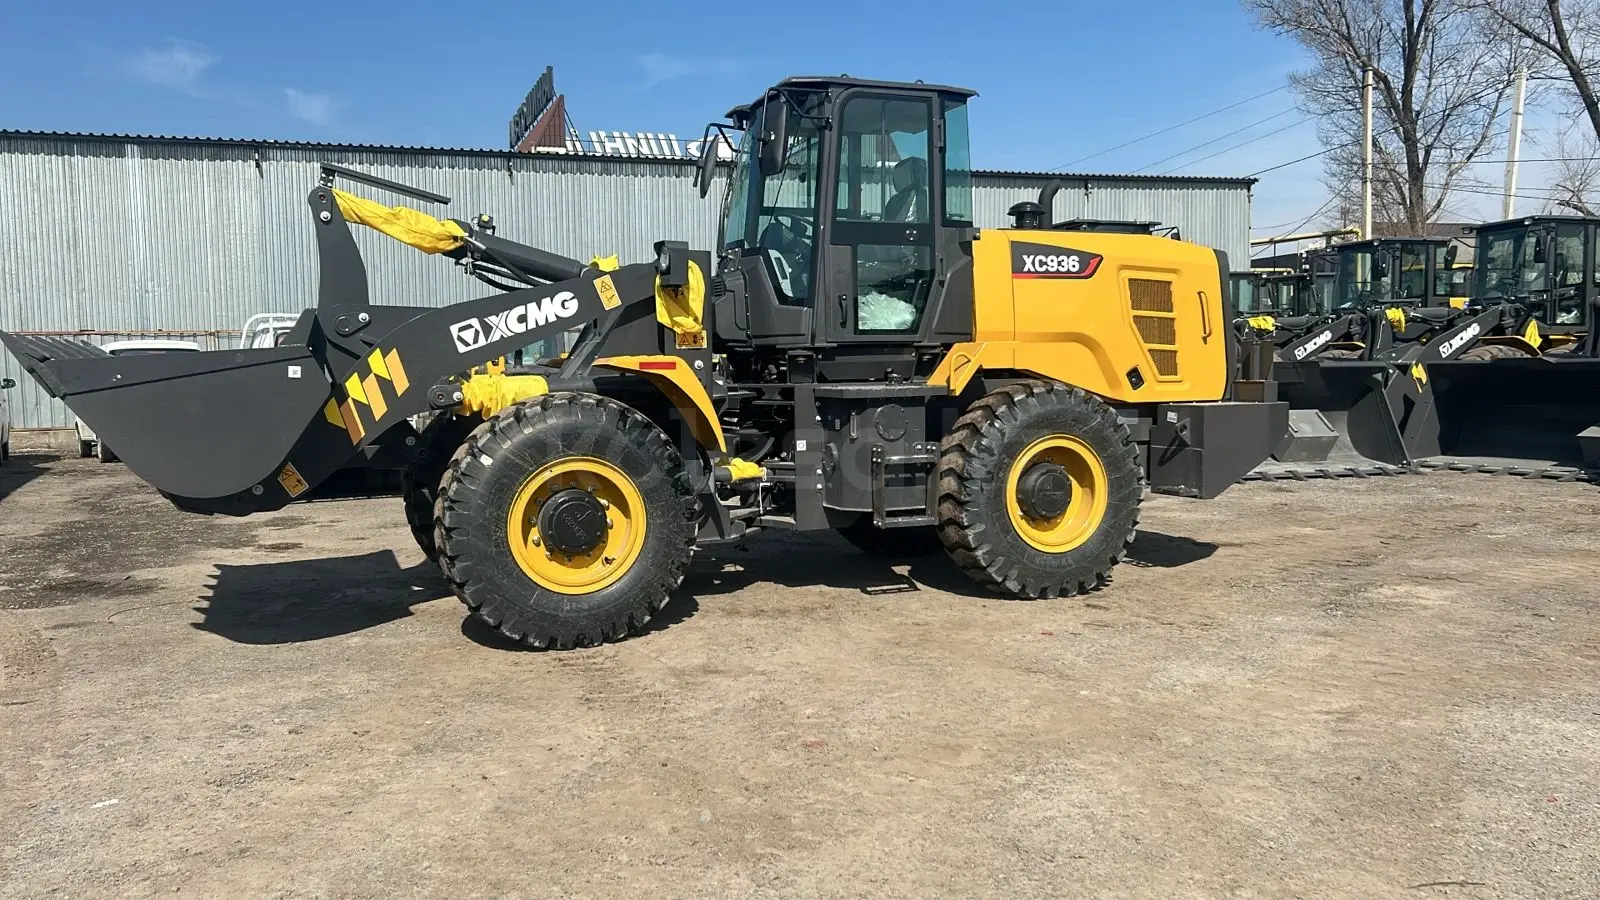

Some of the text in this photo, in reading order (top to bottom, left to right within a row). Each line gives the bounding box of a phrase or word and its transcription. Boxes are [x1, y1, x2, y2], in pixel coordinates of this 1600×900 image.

[1022, 255, 1080, 272] XC936
[483, 291, 579, 343] XCMG
[1303, 330, 1332, 354] XCMG
[1448, 323, 1480, 351] XCMG
